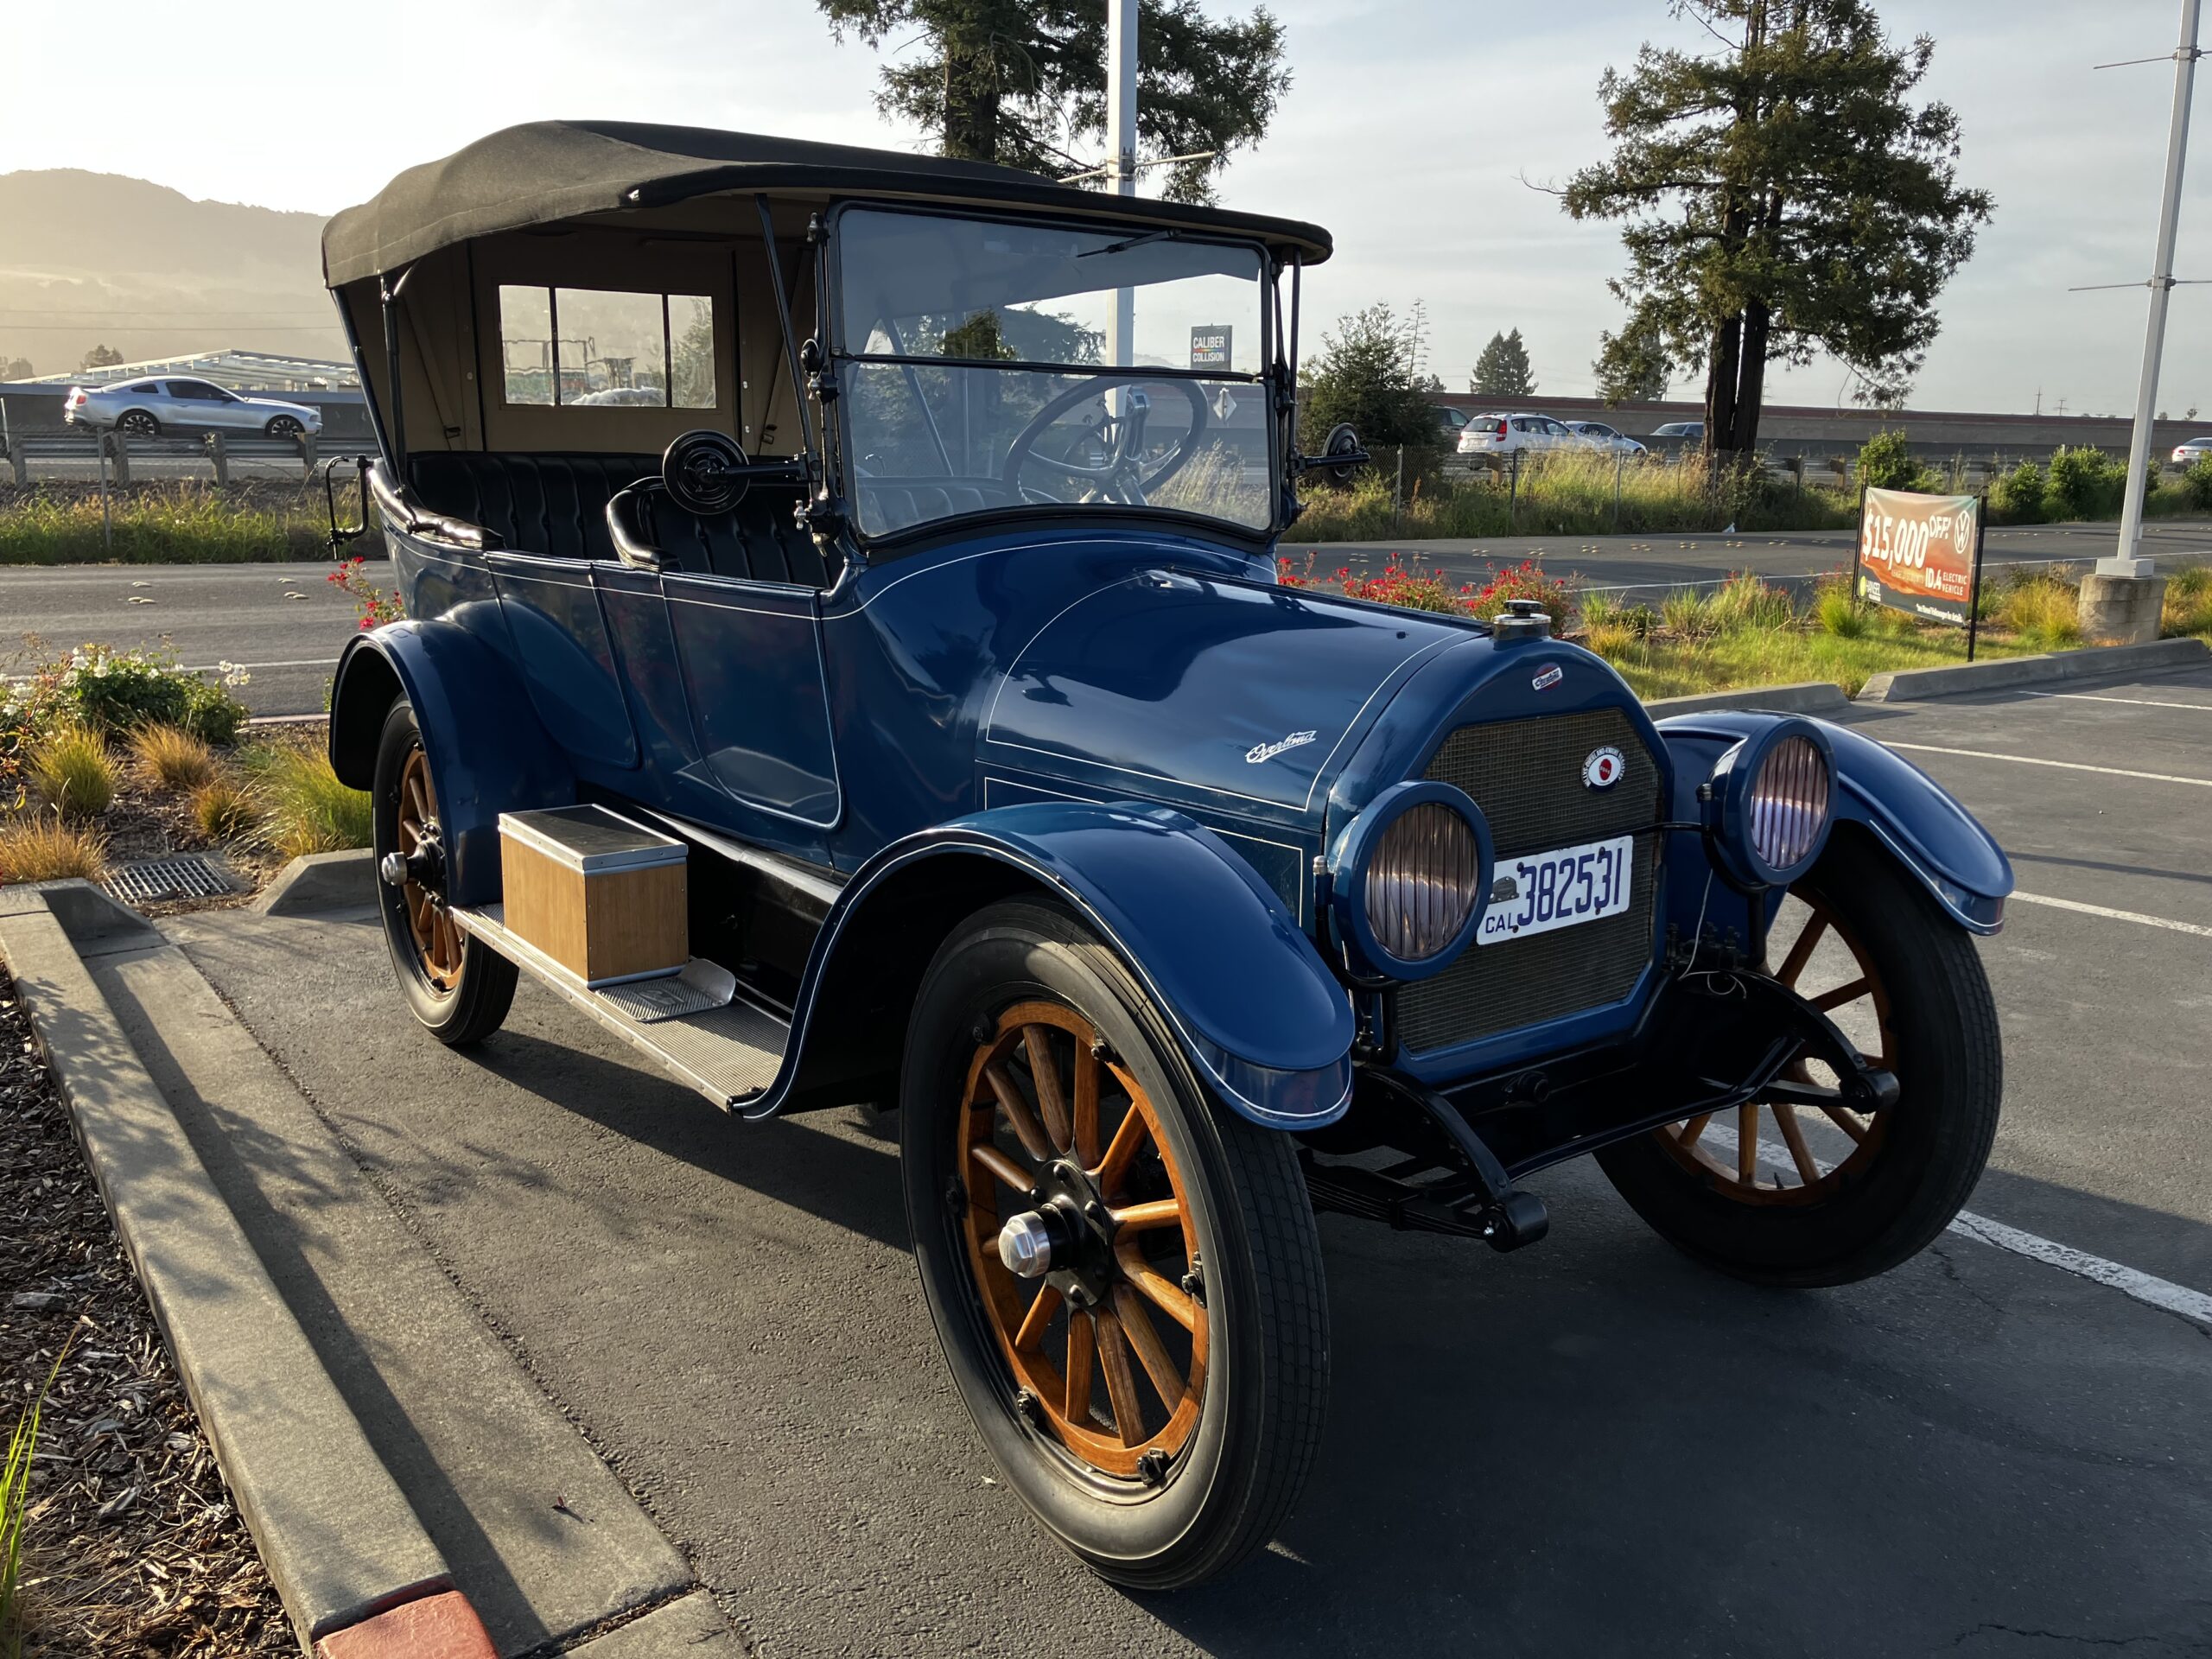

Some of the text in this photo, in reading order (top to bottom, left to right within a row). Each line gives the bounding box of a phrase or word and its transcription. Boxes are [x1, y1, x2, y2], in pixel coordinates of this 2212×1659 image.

[1192, 336, 1224, 348] CALIBER
[1192, 352, 1224, 362] COLLISION
[1862, 508, 1952, 570] $15,000 OFF!
[1942, 572, 1967, 585] ELECTRIC
[1942, 583, 1964, 596] VEHICLE
[1517, 848, 1623, 926] 382531
